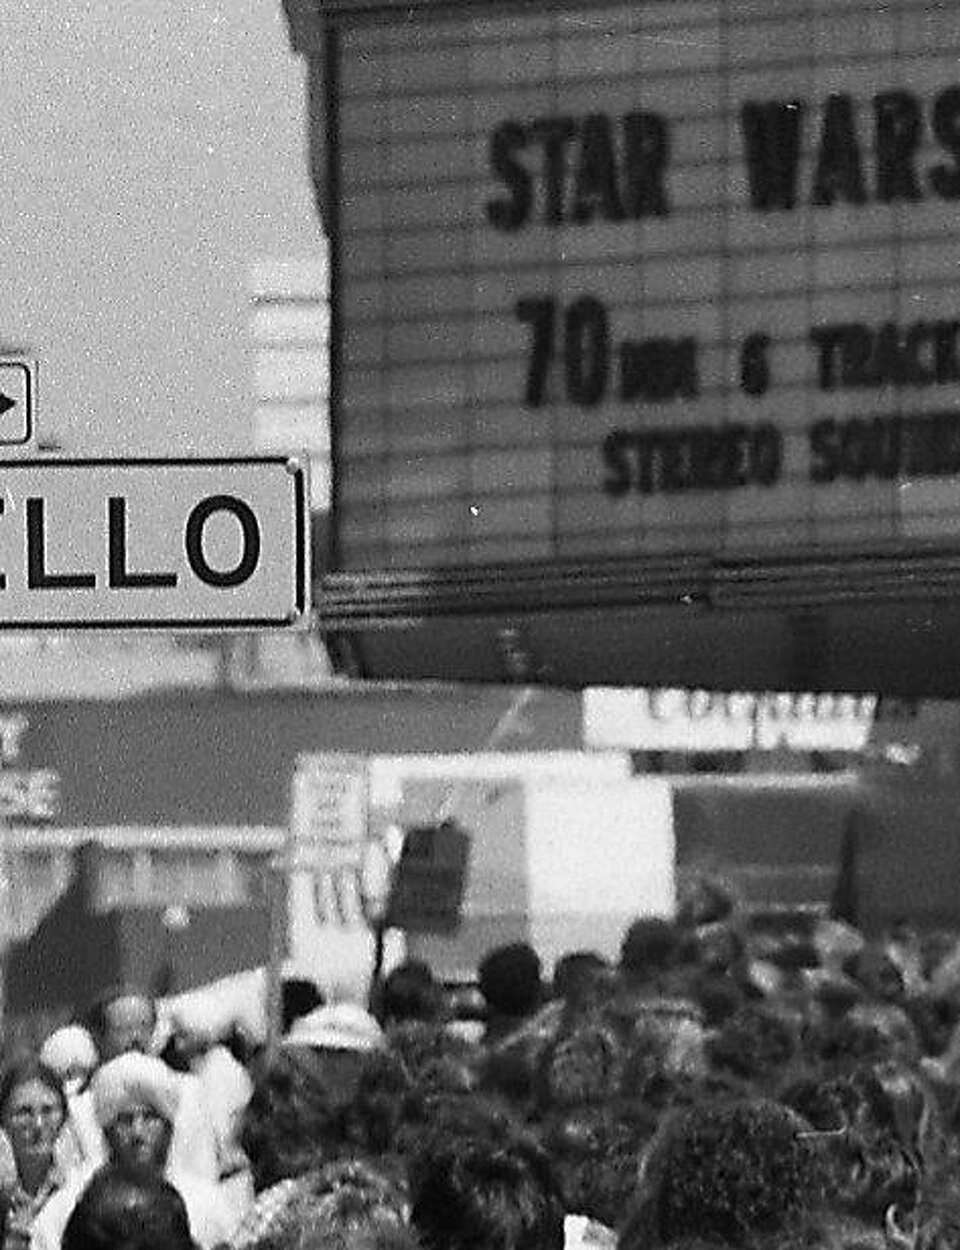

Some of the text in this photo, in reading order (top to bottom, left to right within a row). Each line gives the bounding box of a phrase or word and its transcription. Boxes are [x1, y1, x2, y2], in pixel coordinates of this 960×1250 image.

[486, 112, 671, 231] STAR
[739, 331, 770, 395] 6
[602, 422, 784, 496] STEREO
[0, 494, 261, 588] LLO
